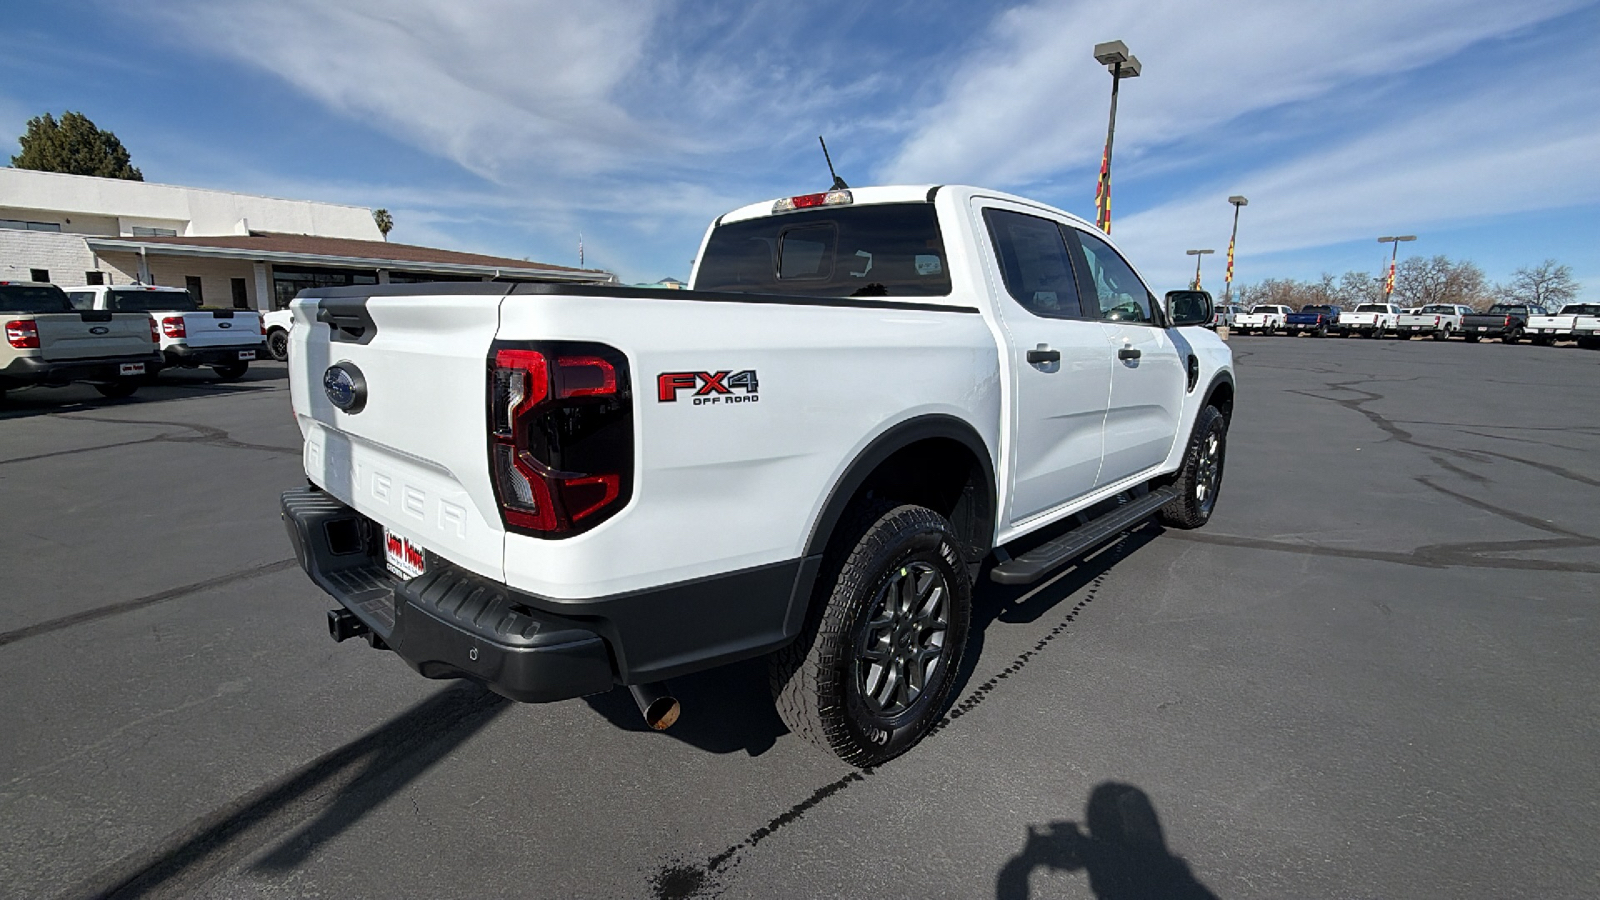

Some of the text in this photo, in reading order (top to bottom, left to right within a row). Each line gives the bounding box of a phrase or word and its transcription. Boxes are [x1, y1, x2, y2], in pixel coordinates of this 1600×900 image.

[657, 371, 759, 402] FX4
[693, 395, 759, 405] OFF ROAD
